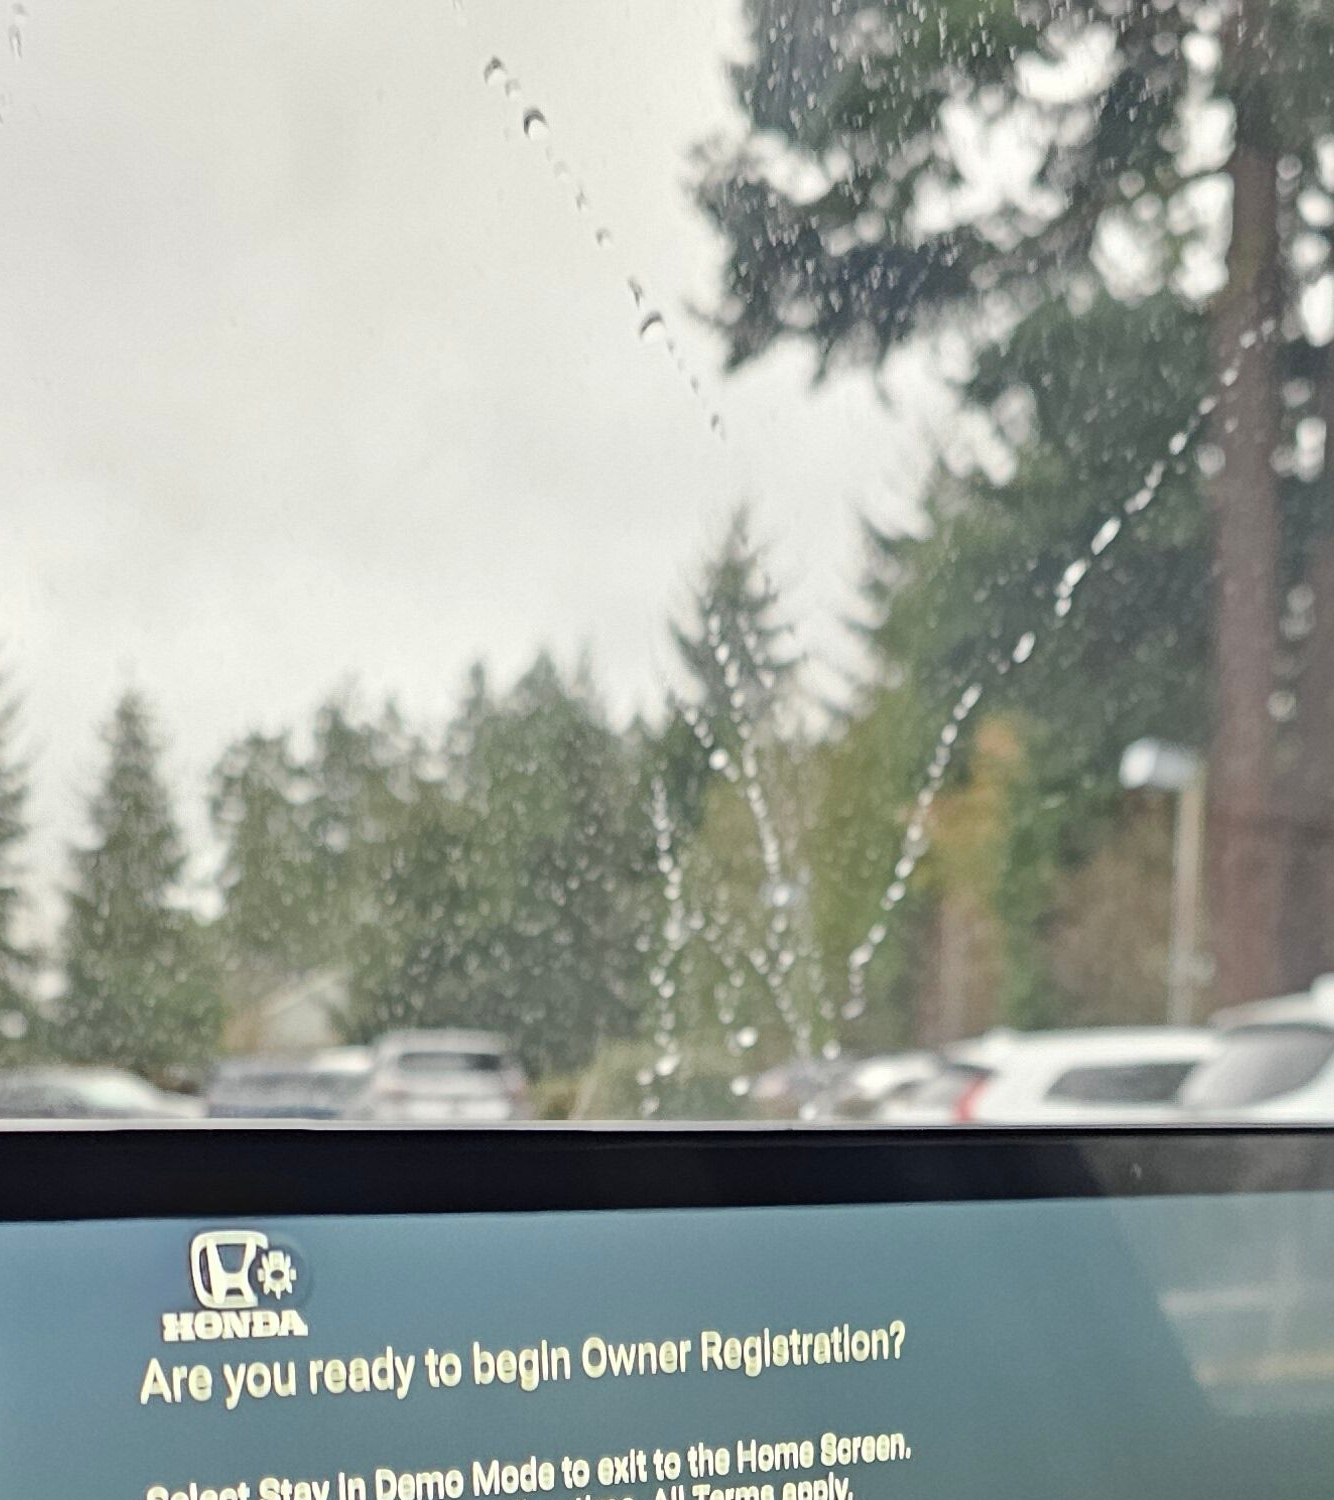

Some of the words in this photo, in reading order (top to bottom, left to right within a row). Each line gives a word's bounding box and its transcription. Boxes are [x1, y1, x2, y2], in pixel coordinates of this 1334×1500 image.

[163, 1310, 309, 1342] HONDA
[140, 1357, 213, 1405] Are
[223, 1361, 297, 1410] you
[310, 1345, 416, 1400] ready
[425, 1348, 462, 1388] to
[473, 1339, 571, 1392] begin
[581, 1336, 692, 1378] Owner
[700, 1319, 906, 1377] Registration?
[472, 1456, 555, 1497] Mode
[561, 1456, 591, 1489] to
[597, 1448, 648, 1486] exit
[653, 1448, 681, 1480] to
[687, 1442, 731, 1478] the
[737, 1439, 815, 1474] Home
[820, 1432, 912, 1466] Screen.
